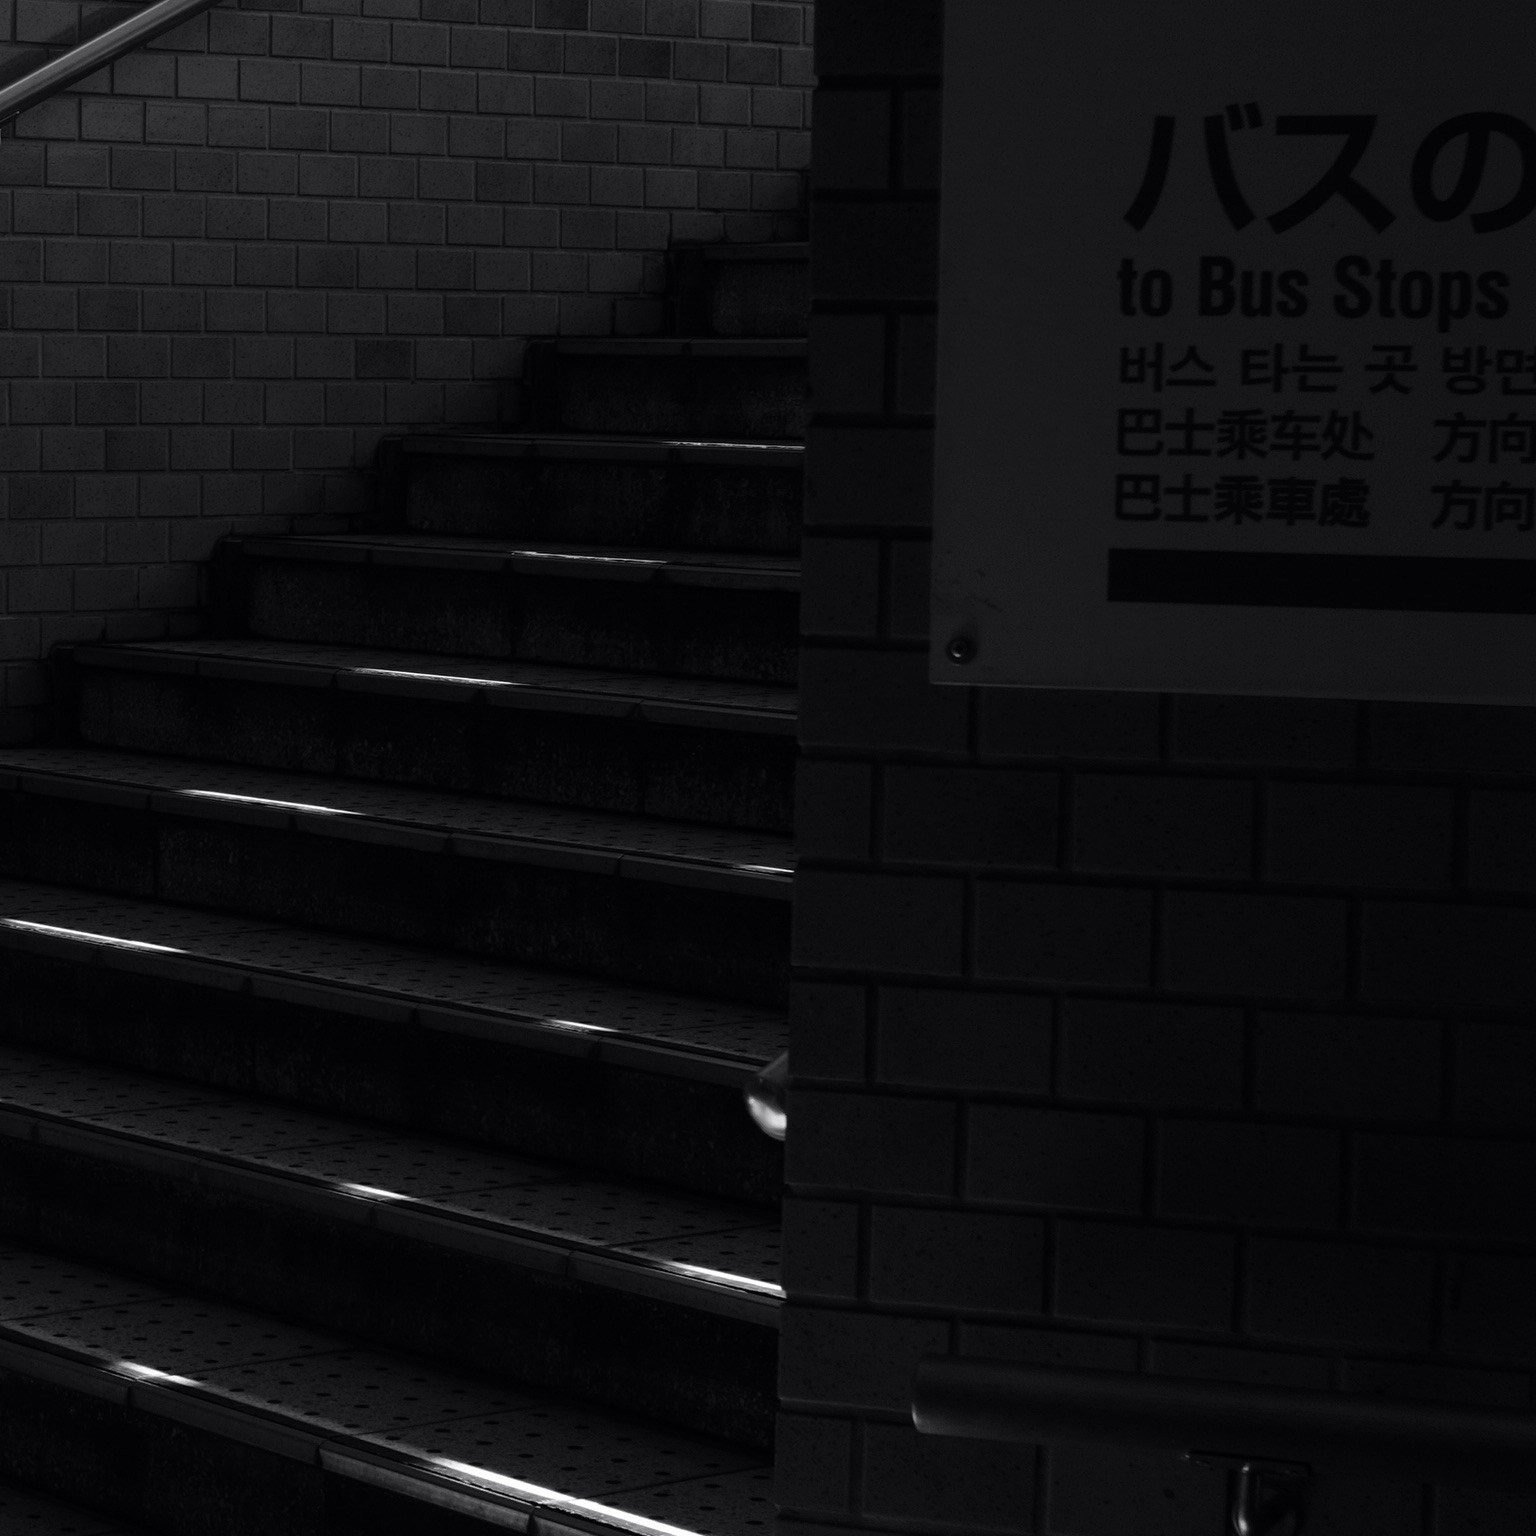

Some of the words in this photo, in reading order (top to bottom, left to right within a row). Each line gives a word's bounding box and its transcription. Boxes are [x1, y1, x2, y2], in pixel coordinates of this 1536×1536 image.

[1123, 102, 1536, 234] バスの
[1117, 258, 1173, 318] to
[1198, 255, 1309, 318] Bus
[1333, 255, 1510, 333] Stops
[1120, 342, 1216, 392] 버스
[1241, 342, 1343, 393] 타는
[1365, 344, 1418, 394] 곳
[1117, 407, 1374, 462] 巴士乘车处
[1433, 411, 1536, 464] 方向
[1114, 473, 1371, 529] 巴士乘車處
[1430, 479, 1536, 532] 方向
